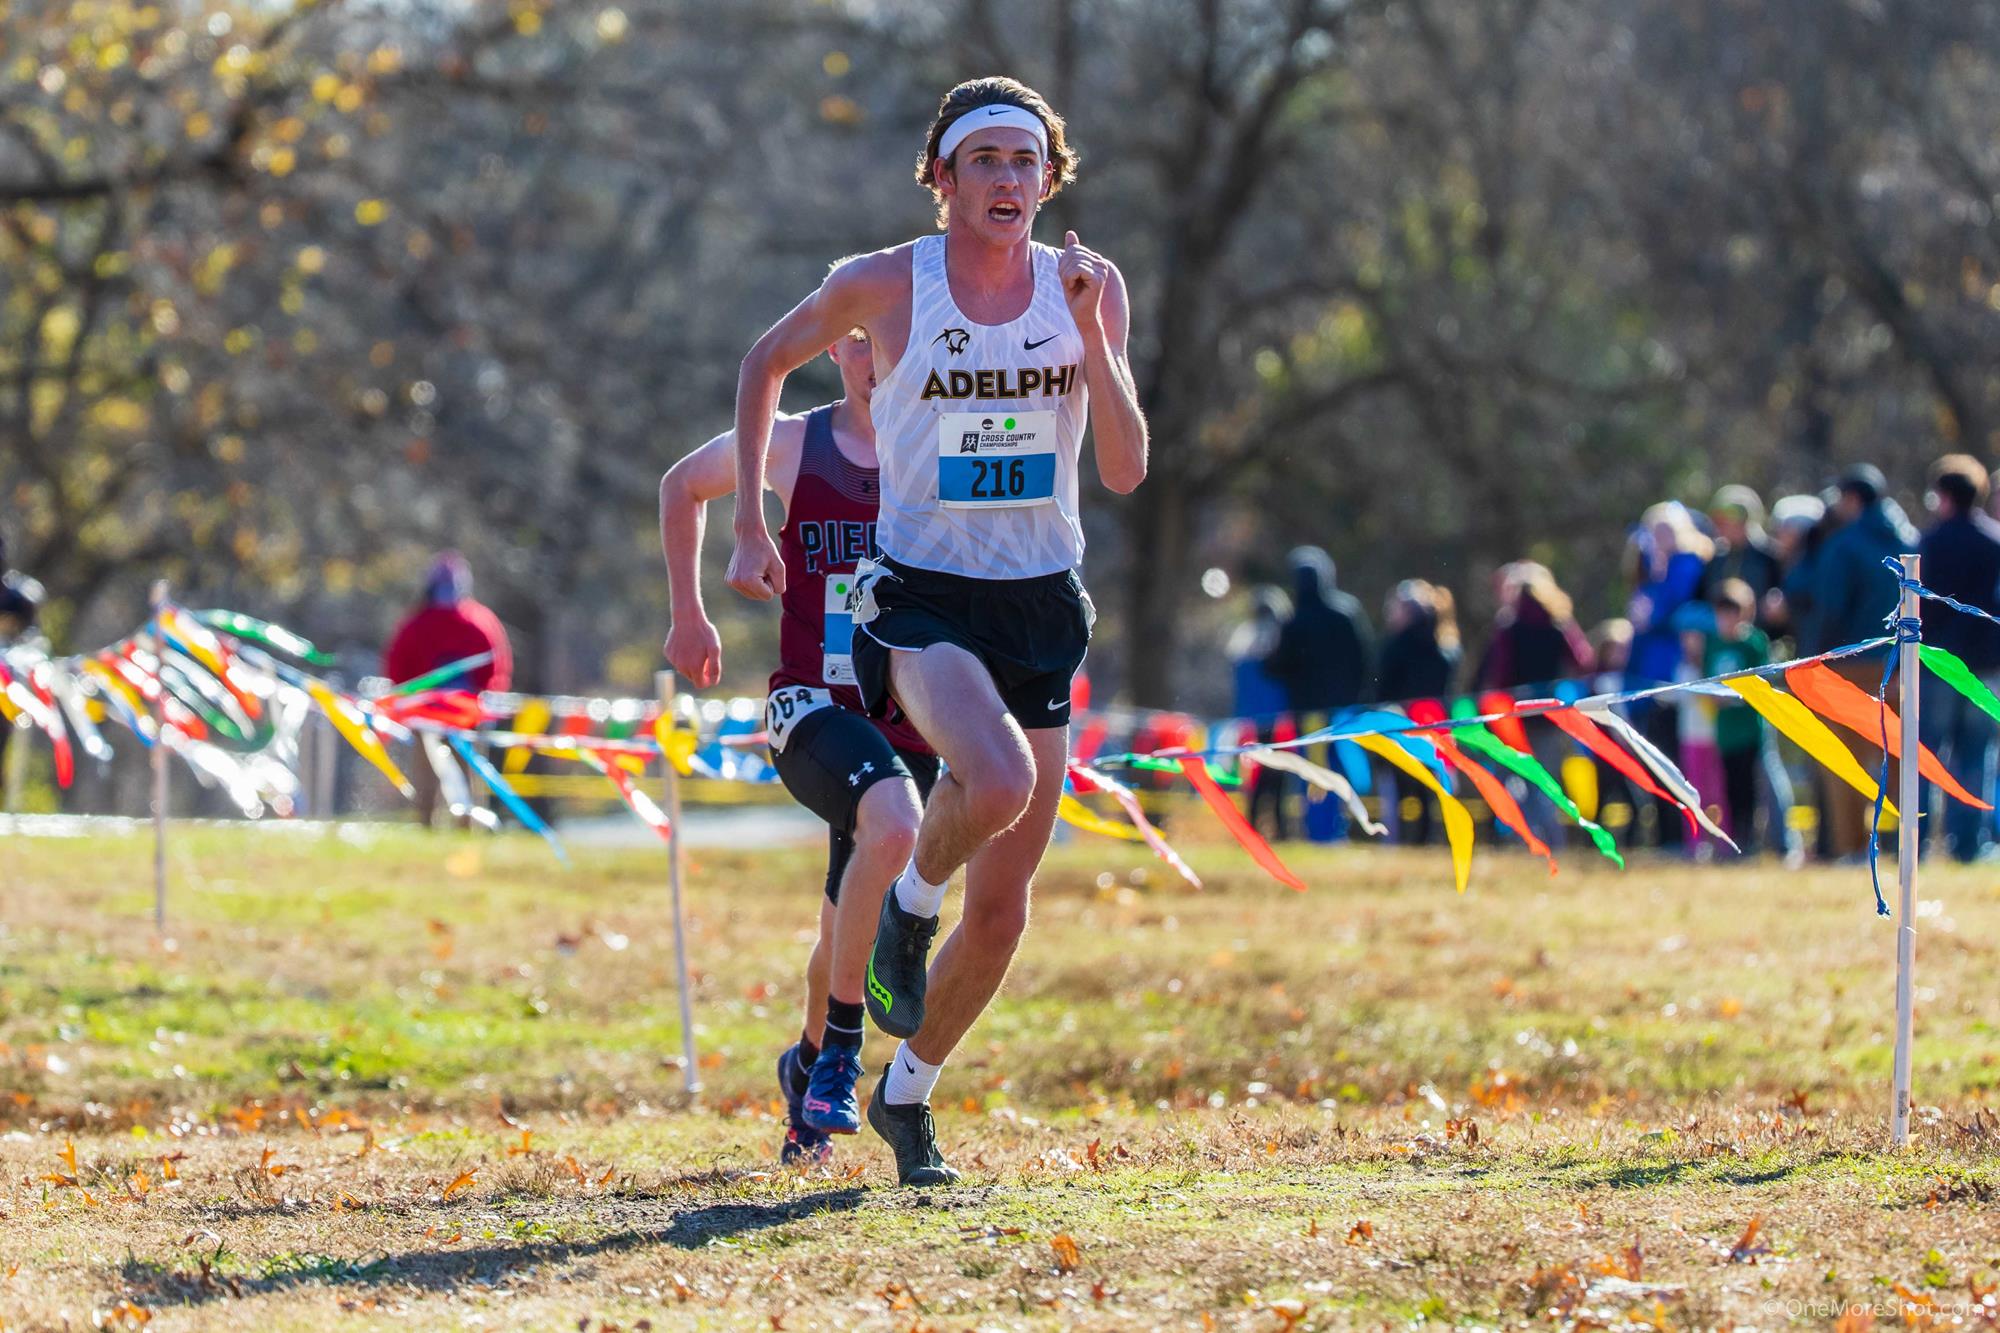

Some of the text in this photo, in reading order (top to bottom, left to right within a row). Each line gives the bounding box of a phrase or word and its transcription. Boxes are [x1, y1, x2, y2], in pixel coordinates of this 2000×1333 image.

[920, 363, 1078, 401] ADELPHI
[980, 434, 1005, 442] CROSS
[1006, 432, 1037, 442] COUNTRY
[971, 459, 1025, 498] 216
